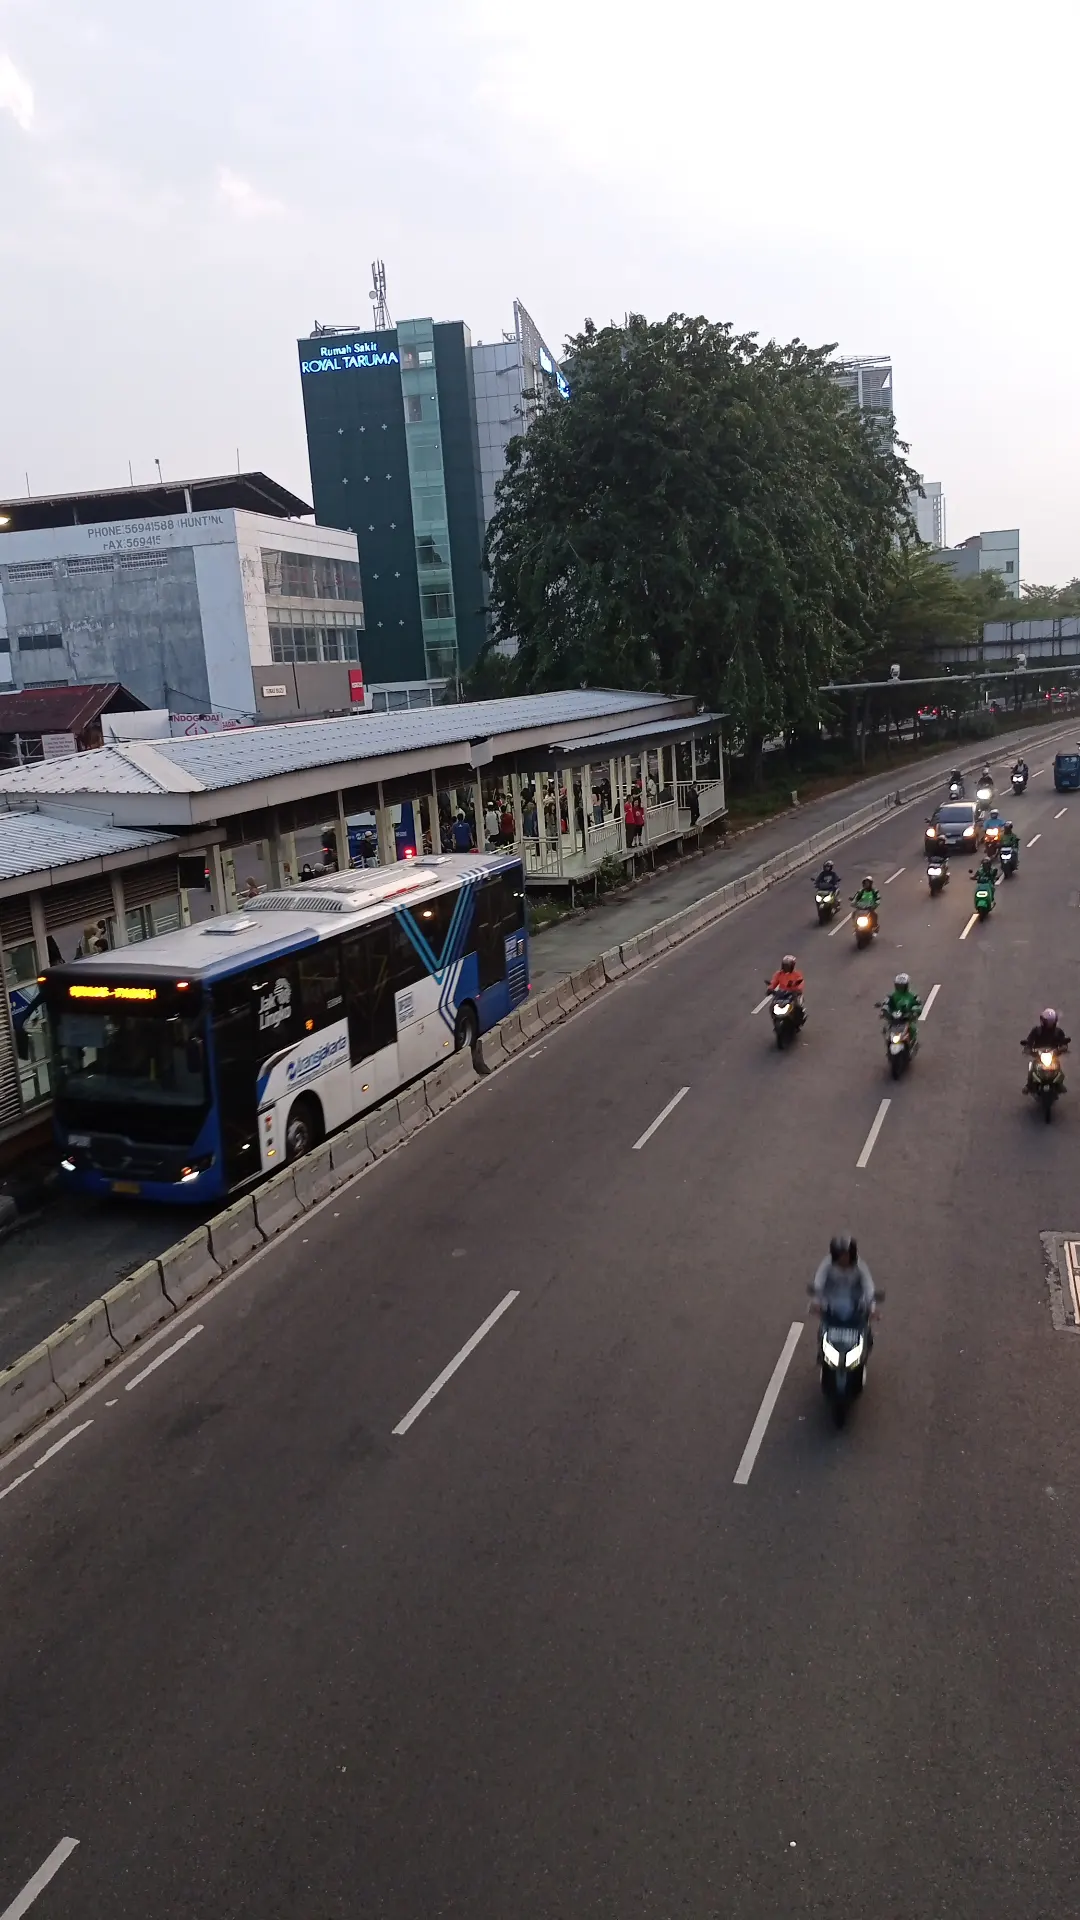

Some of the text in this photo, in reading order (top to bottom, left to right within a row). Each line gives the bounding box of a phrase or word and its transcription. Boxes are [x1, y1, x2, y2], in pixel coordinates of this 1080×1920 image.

[320, 342, 377, 357] Rumah Sakit
[301, 351, 400, 374] ROYAL TARUMA
[258, 992, 277, 1015] Jak
[259, 1004, 292, 1031] Lingko
[296, 1036, 347, 1076] transjakarta
